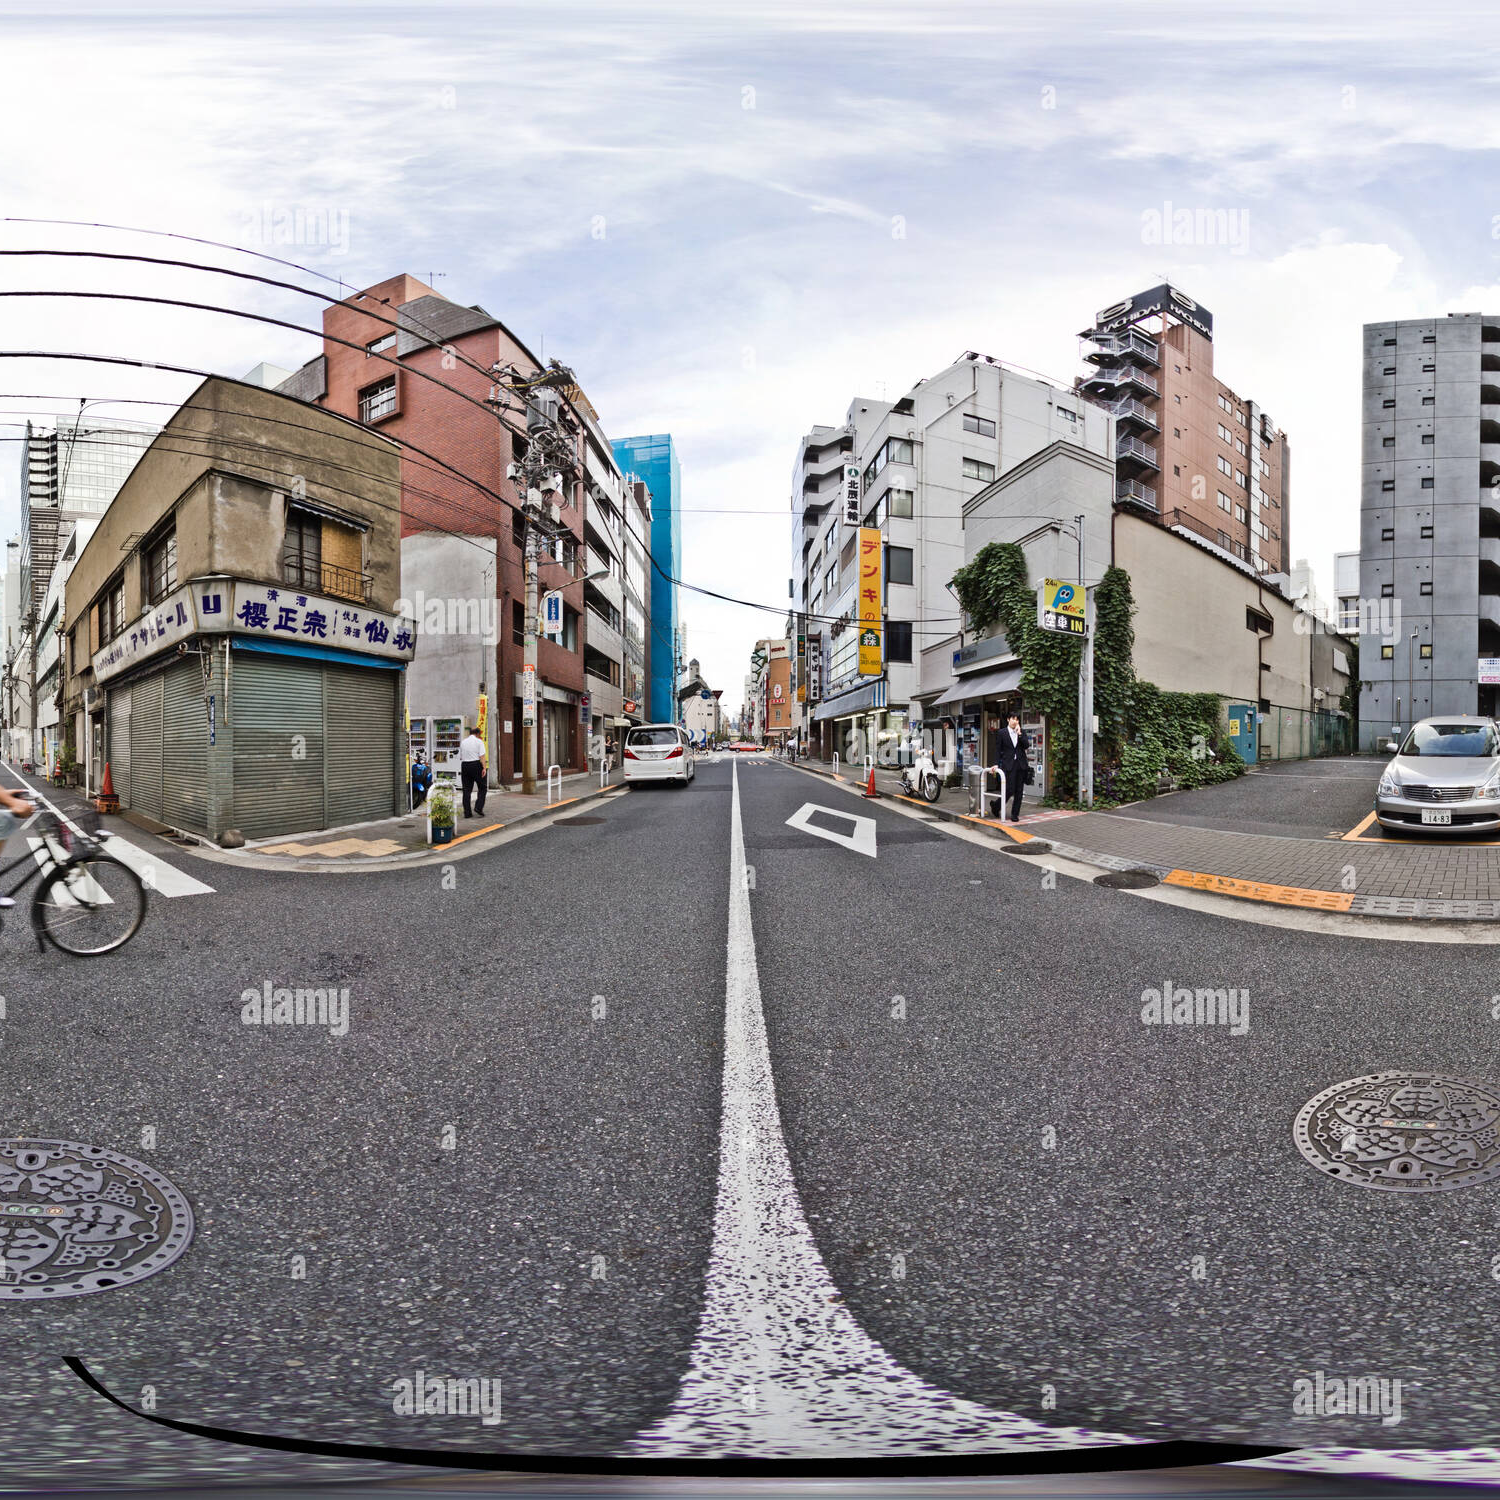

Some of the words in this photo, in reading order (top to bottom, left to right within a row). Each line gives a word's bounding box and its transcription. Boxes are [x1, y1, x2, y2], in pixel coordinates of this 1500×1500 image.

[861, 540, 880, 646] デンキの森
[1045, 611, 1068, 630] 空車
[1070, 619, 1083, 633] IN
